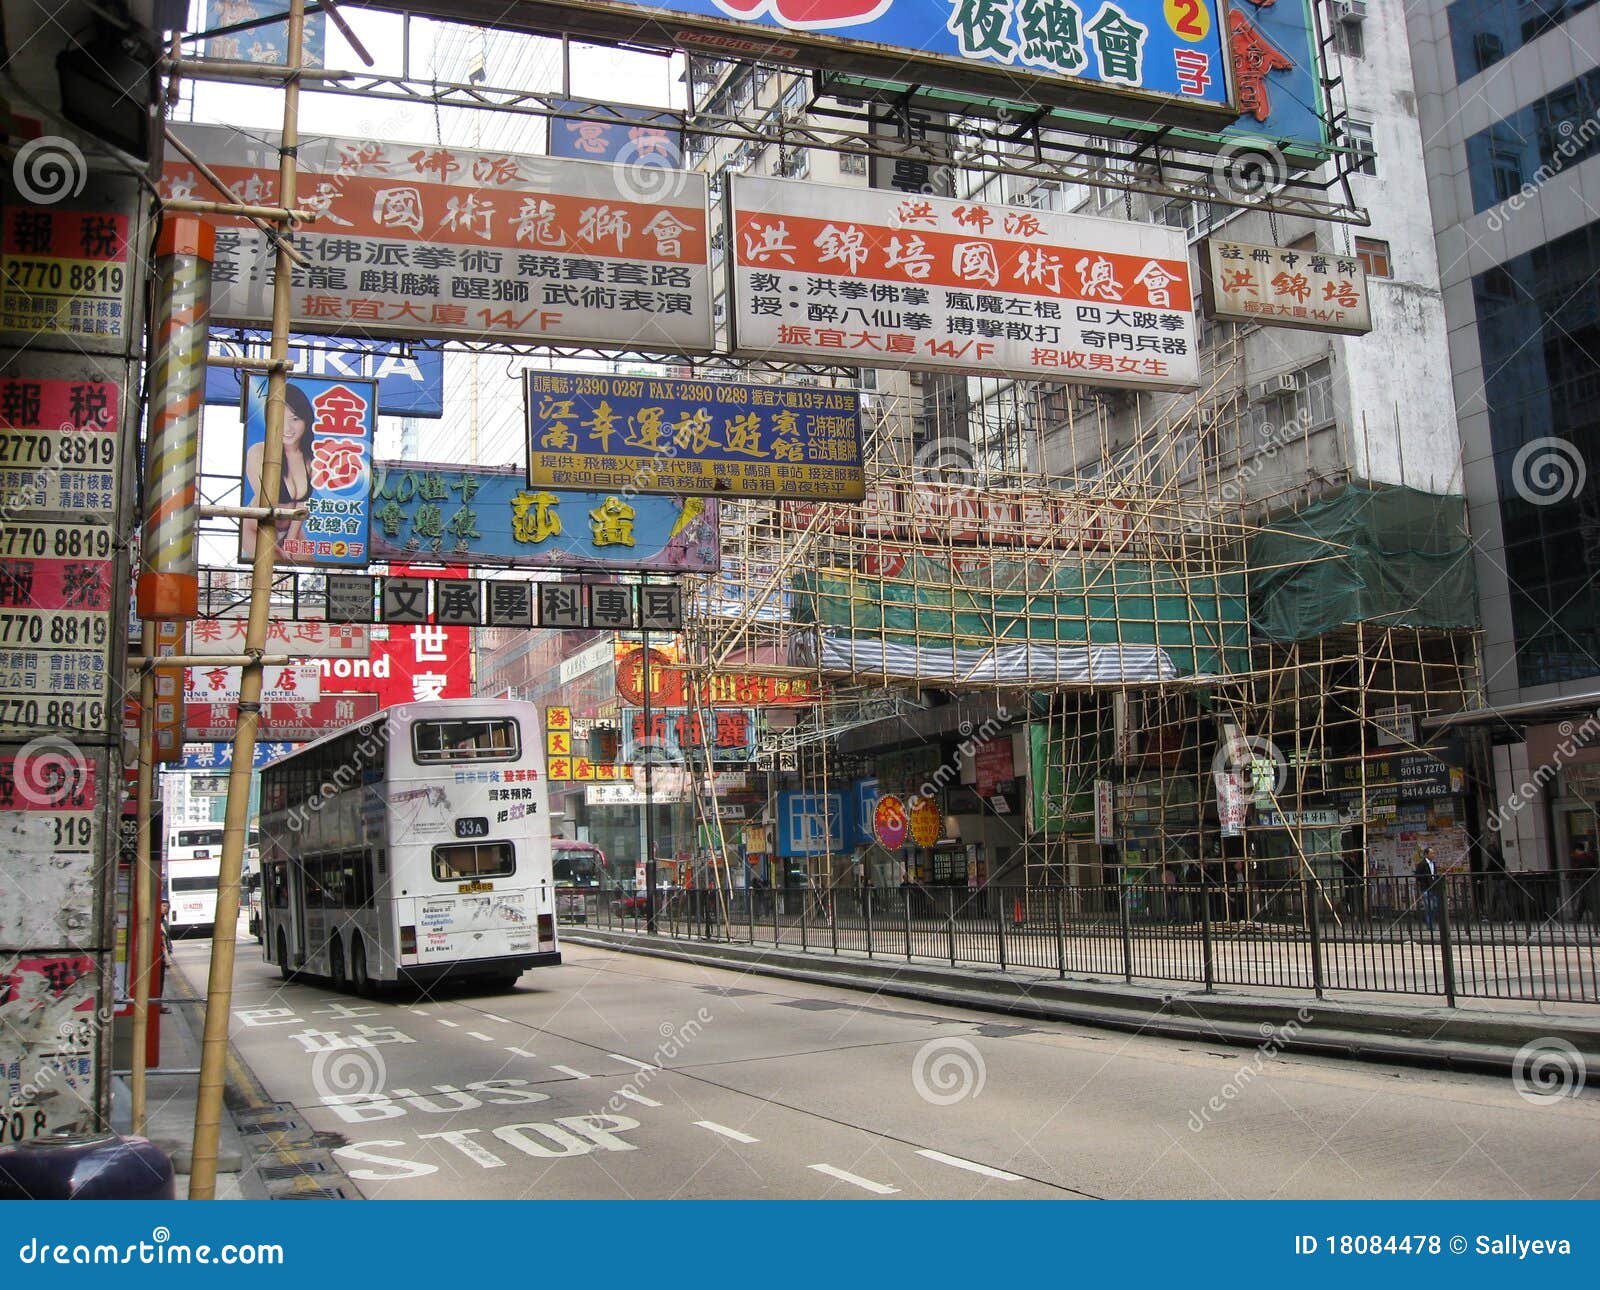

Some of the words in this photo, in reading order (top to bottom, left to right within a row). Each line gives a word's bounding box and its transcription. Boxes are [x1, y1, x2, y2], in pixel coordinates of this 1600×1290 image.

[954, 0, 1145, 84] 夜總會
[342, 144, 529, 185] 洪佛派
[897, 200, 1048, 237] 洪佛派
[6, 260, 62, 288] 2770
[70, 264, 124, 294] 8819
[517, 253, 692, 289] 競賽套路
[743, 219, 1183, 308] 洪錦培國術總會
[359, 268, 441, 297] 麒麟
[451, 275, 529, 303] 醒獅
[541, 283, 693, 316] 武術表演
[1221, 267, 1361, 308] 洪錦培
[70, 299, 122, 317] 會計核數
[945, 290, 1062, 320] 瘋魔左棍
[946, 315, 1060, 345] 搏擊散打
[1080, 329, 1188, 355] 奇門兵器
[208, 334, 424, 382] NOKIA
[1031, 347, 1169, 377] 招收男女生
[575, 377, 609, 397] 2390
[612, 379, 645, 398] 0287
[681, 384, 713, 403] 2390
[716, 385, 748, 404] 0289
[0, 435, 51, 463] 2770
[59, 436, 115, 465] 8819
[312, 384, 367, 490] 金莎
[59, 473, 113, 491] 會計核數
[713, 462, 741, 476] 機場
[776, 465, 804, 479] 車站
[59, 491, 113, 509] 清盤除名
[306, 499, 363, 515] 卡拉OK
[306, 517, 361, 534] 夜總會
[0, 526, 46, 557] 770
[54, 528, 110, 558] 8819
[51, 614, 107, 645] 8819
[50, 654, 105, 671] 會計核數
[49, 672, 104, 690] 清盤除名
[264, 690, 298, 698] HOTEL
[47, 700, 103, 729] 8819
[269, 719, 304, 729] GUAN
[1424, 763, 1446, 774] 7270
[460, 820, 483, 836] 33A
[318, 1079, 552, 1124] BUS
[331, 1113, 641, 1181] STOP
